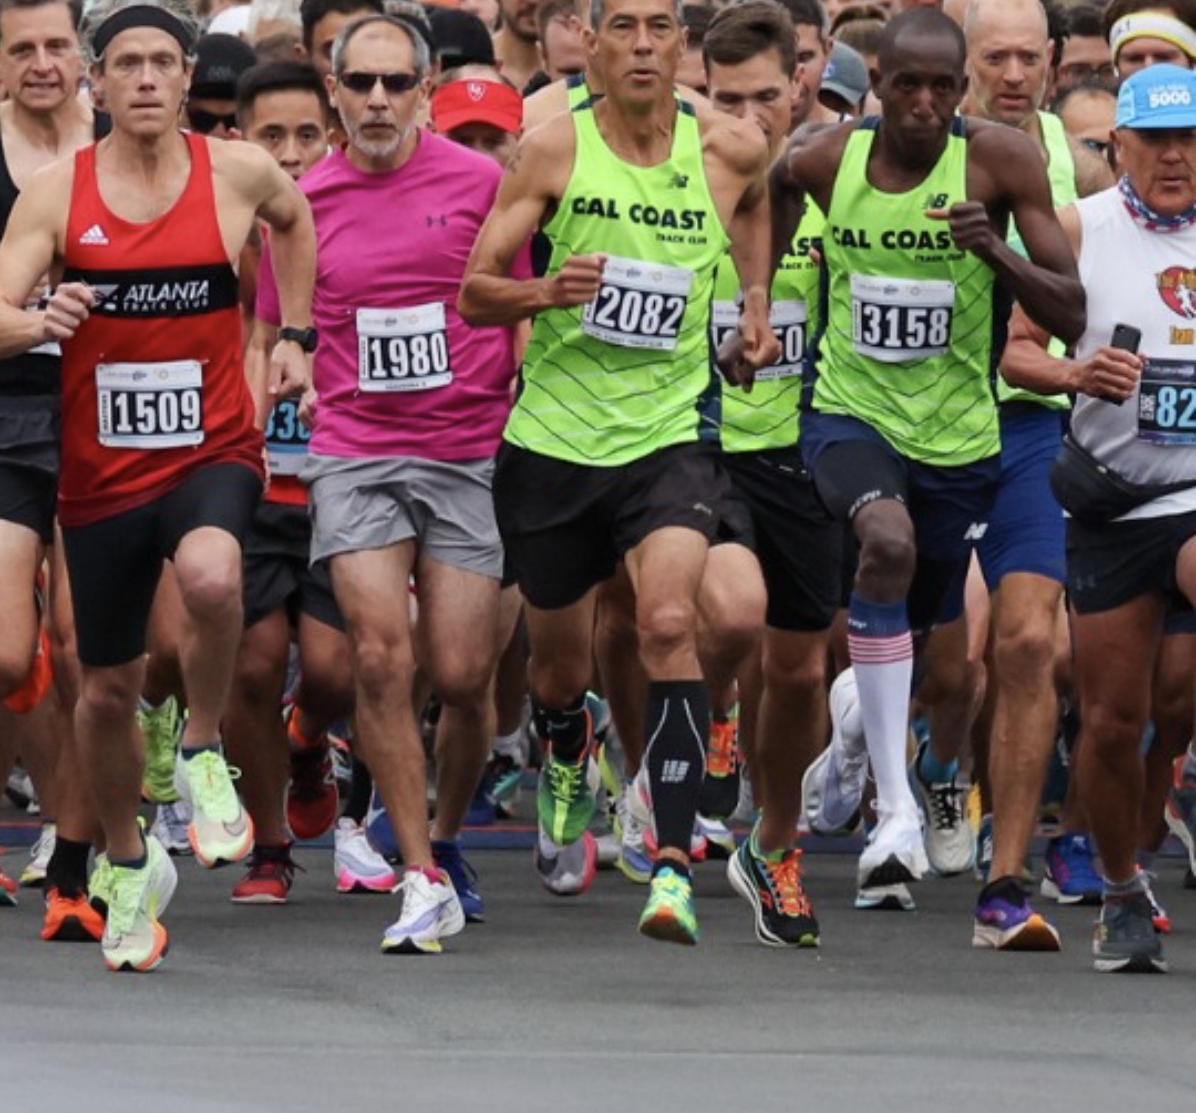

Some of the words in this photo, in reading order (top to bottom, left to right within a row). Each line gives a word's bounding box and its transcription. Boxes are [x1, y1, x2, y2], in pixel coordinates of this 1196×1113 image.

[1149, 91, 1190, 108] 5000
[572, 196, 620, 220] CAL
[629, 203, 707, 231] COAST
[881, 229, 952, 250] COAS
[124, 279, 210, 303] ATLANTA
[594, 286, 687, 337] 2082
[862, 303, 950, 348] 3158
[370, 332, 449, 379] 1980
[114, 389, 201, 434] 1509
